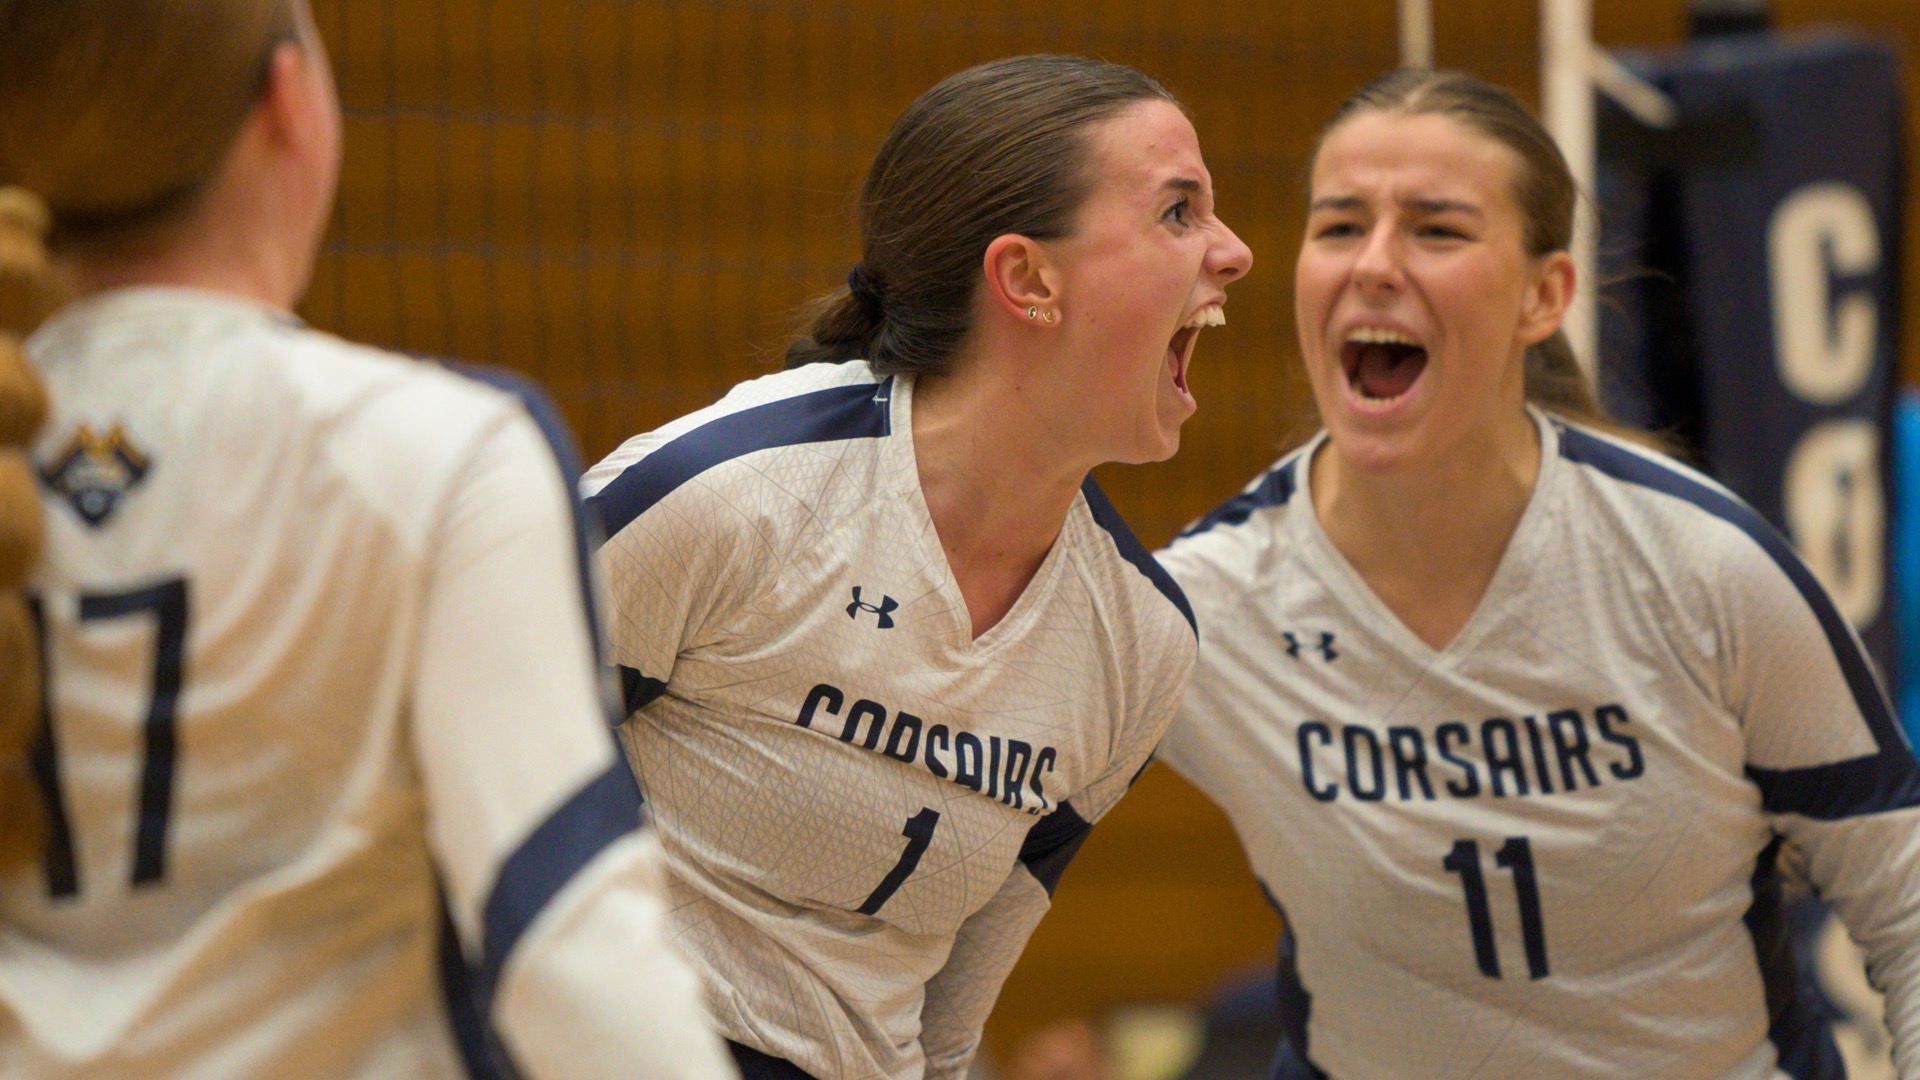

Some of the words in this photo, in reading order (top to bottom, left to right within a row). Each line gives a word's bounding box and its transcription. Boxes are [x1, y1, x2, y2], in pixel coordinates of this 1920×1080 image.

[1297, 704, 1645, 802] CORSAIRS
[859, 806, 940, 916] 1
[1442, 836, 1549, 980] 11
